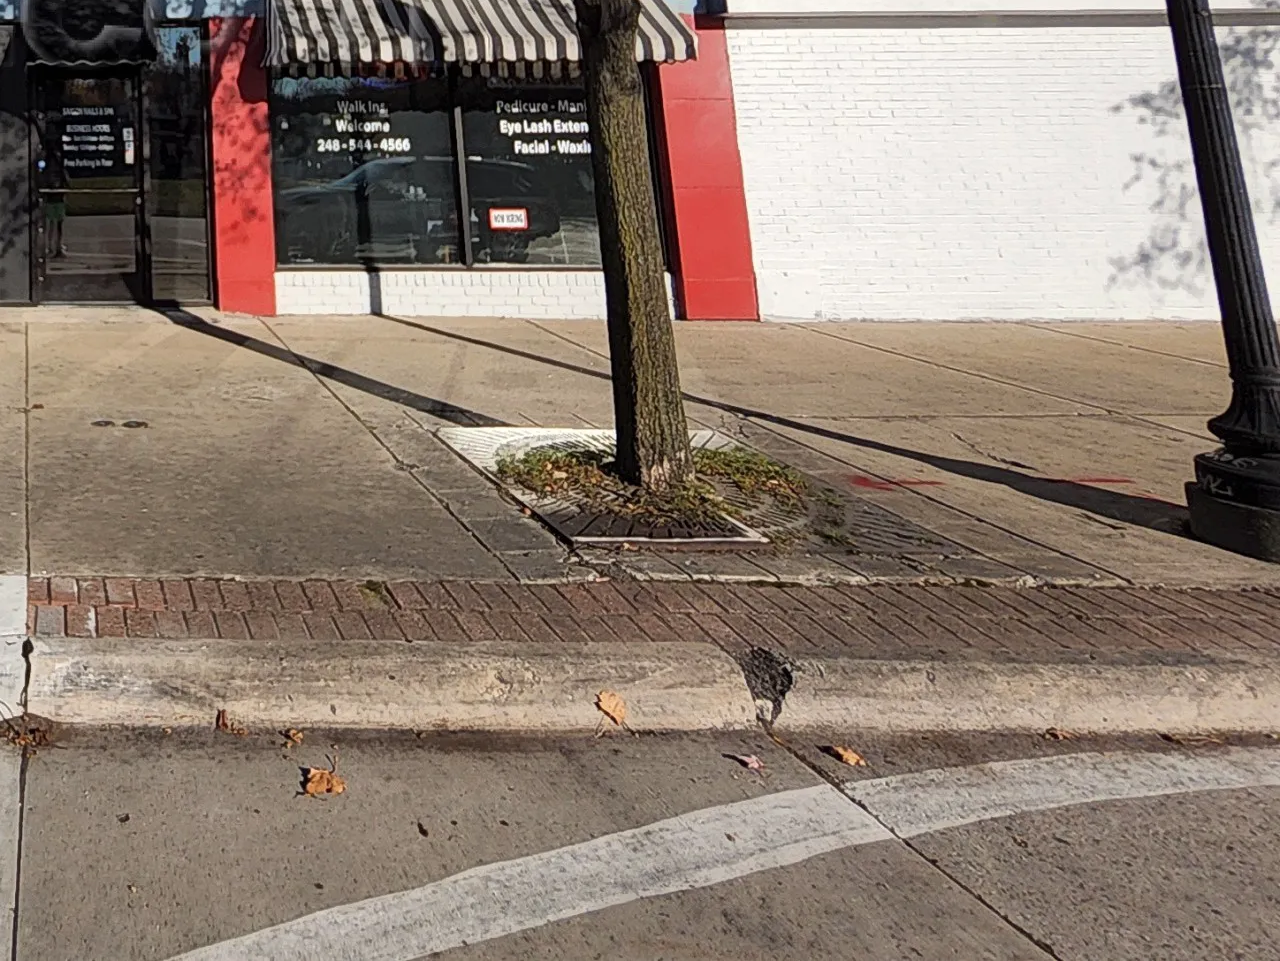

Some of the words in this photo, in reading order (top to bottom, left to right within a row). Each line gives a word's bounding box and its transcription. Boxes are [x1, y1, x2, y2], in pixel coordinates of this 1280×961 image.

[336, 100, 366, 113] Walk
[496, 100, 548, 113] Pedicure
[558, 100, 588, 113] Mani
[335, 119, 390, 133] Welcome
[499, 119, 522, 137] Eye
[523, 119, 552, 134] Lash
[553, 119, 590, 134] Exten
[514, 139, 549, 154] Facial
